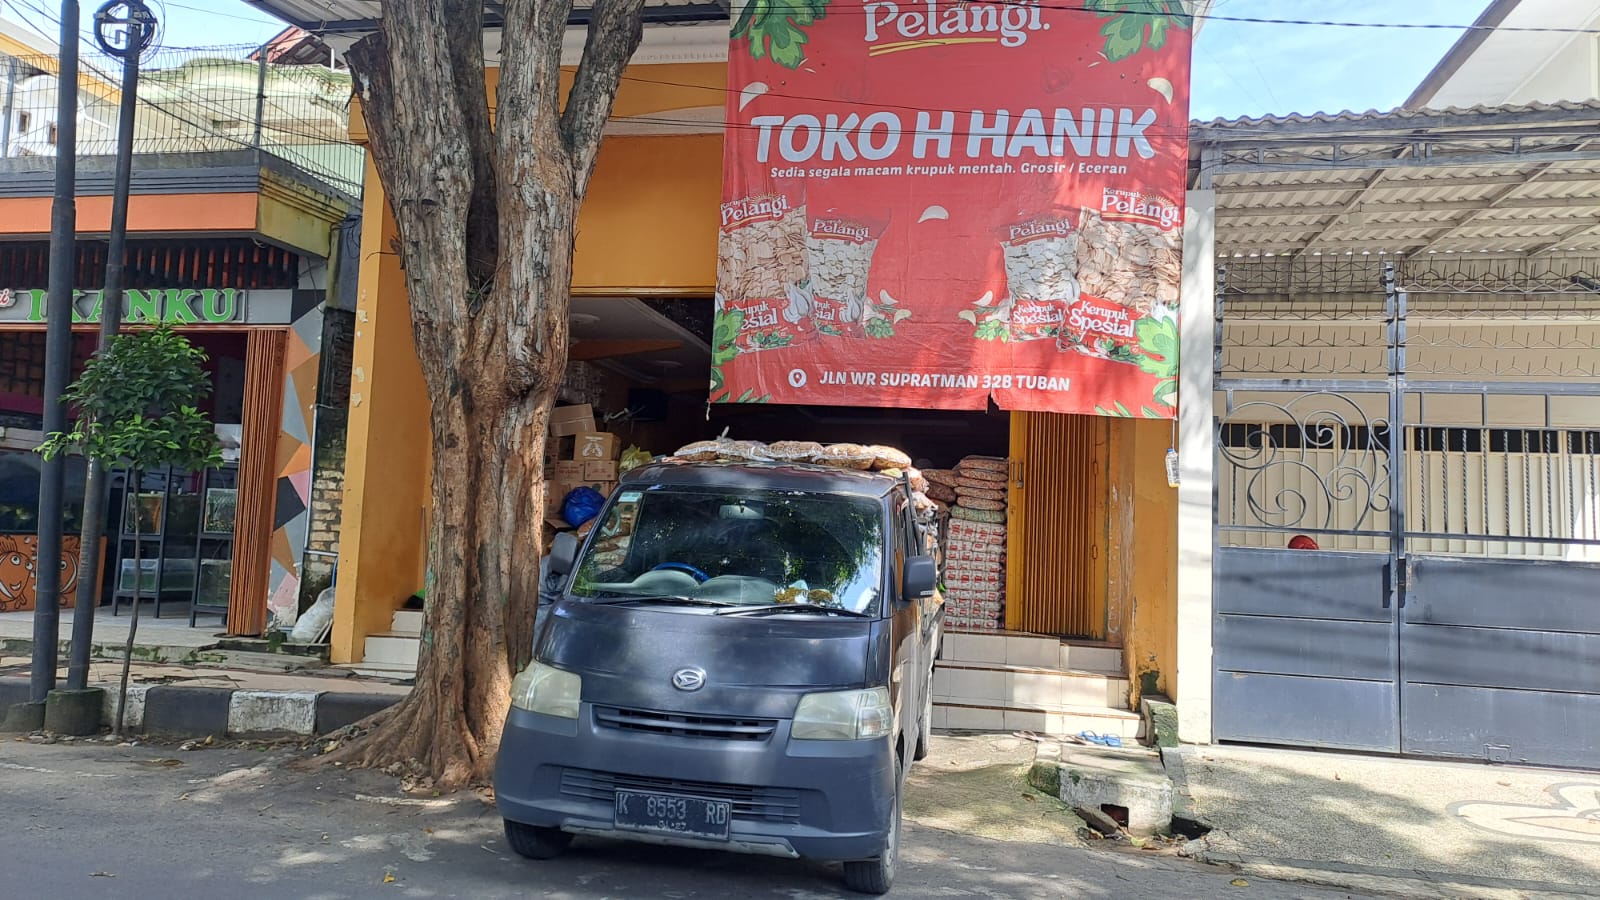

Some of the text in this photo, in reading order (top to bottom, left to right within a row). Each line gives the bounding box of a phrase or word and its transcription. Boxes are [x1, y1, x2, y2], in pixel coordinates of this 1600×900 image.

[750, 107, 1157, 163] TOKO H HANIK
[770, 167, 806, 178] Sedia
[808, 167, 851, 180] segala
[854, 166, 902, 177] macam
[906, 164, 955, 177] krupuk
[958, 163, 1016, 175] mentah.
[1021, 162, 1066, 174] Grosir
[1078, 162, 1128, 175] Eceran
[1013, 308, 1063, 325] Spesial
[1081, 300, 1128, 321] Kerupuk
[1069, 308, 1135, 337] Spesial
[819, 370, 1071, 391] JLN WR SUPRATMAN 32B TUBAN
[617, 793, 728, 825] K 8553 RD
